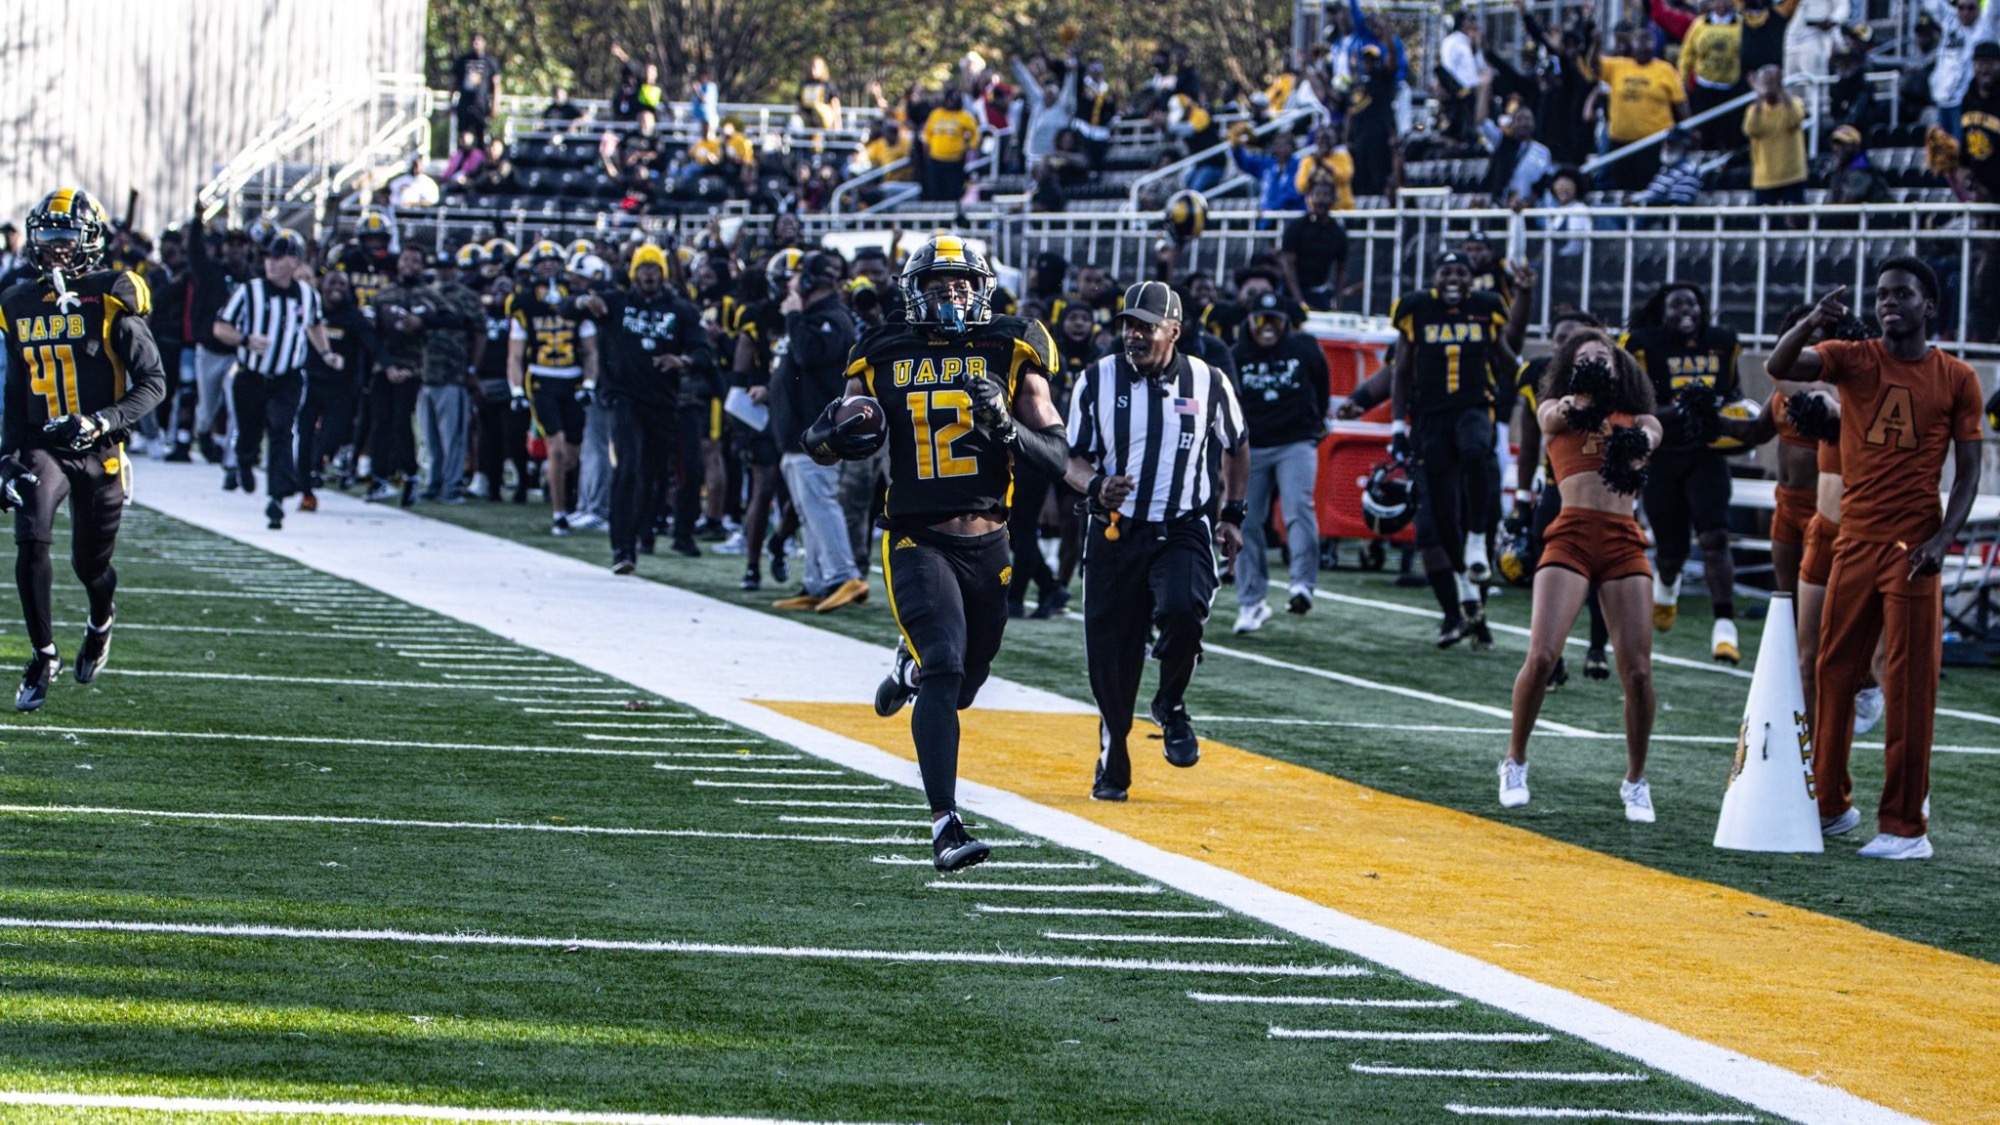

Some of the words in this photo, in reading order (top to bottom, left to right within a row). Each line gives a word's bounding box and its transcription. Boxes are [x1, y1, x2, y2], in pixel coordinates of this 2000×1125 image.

[16, 313, 85, 343] UAPB
[1423, 323, 1482, 343] UAPB
[535, 330, 575, 366] 25
[23, 344, 80, 419] 41
[893, 356, 987, 387] UAPB
[1445, 344, 1461, 394] 1
[1116, 395, 1129, 409] S
[1864, 383, 1919, 450] A
[906, 389, 979, 480] 12
[1180, 432, 1194, 450] H
